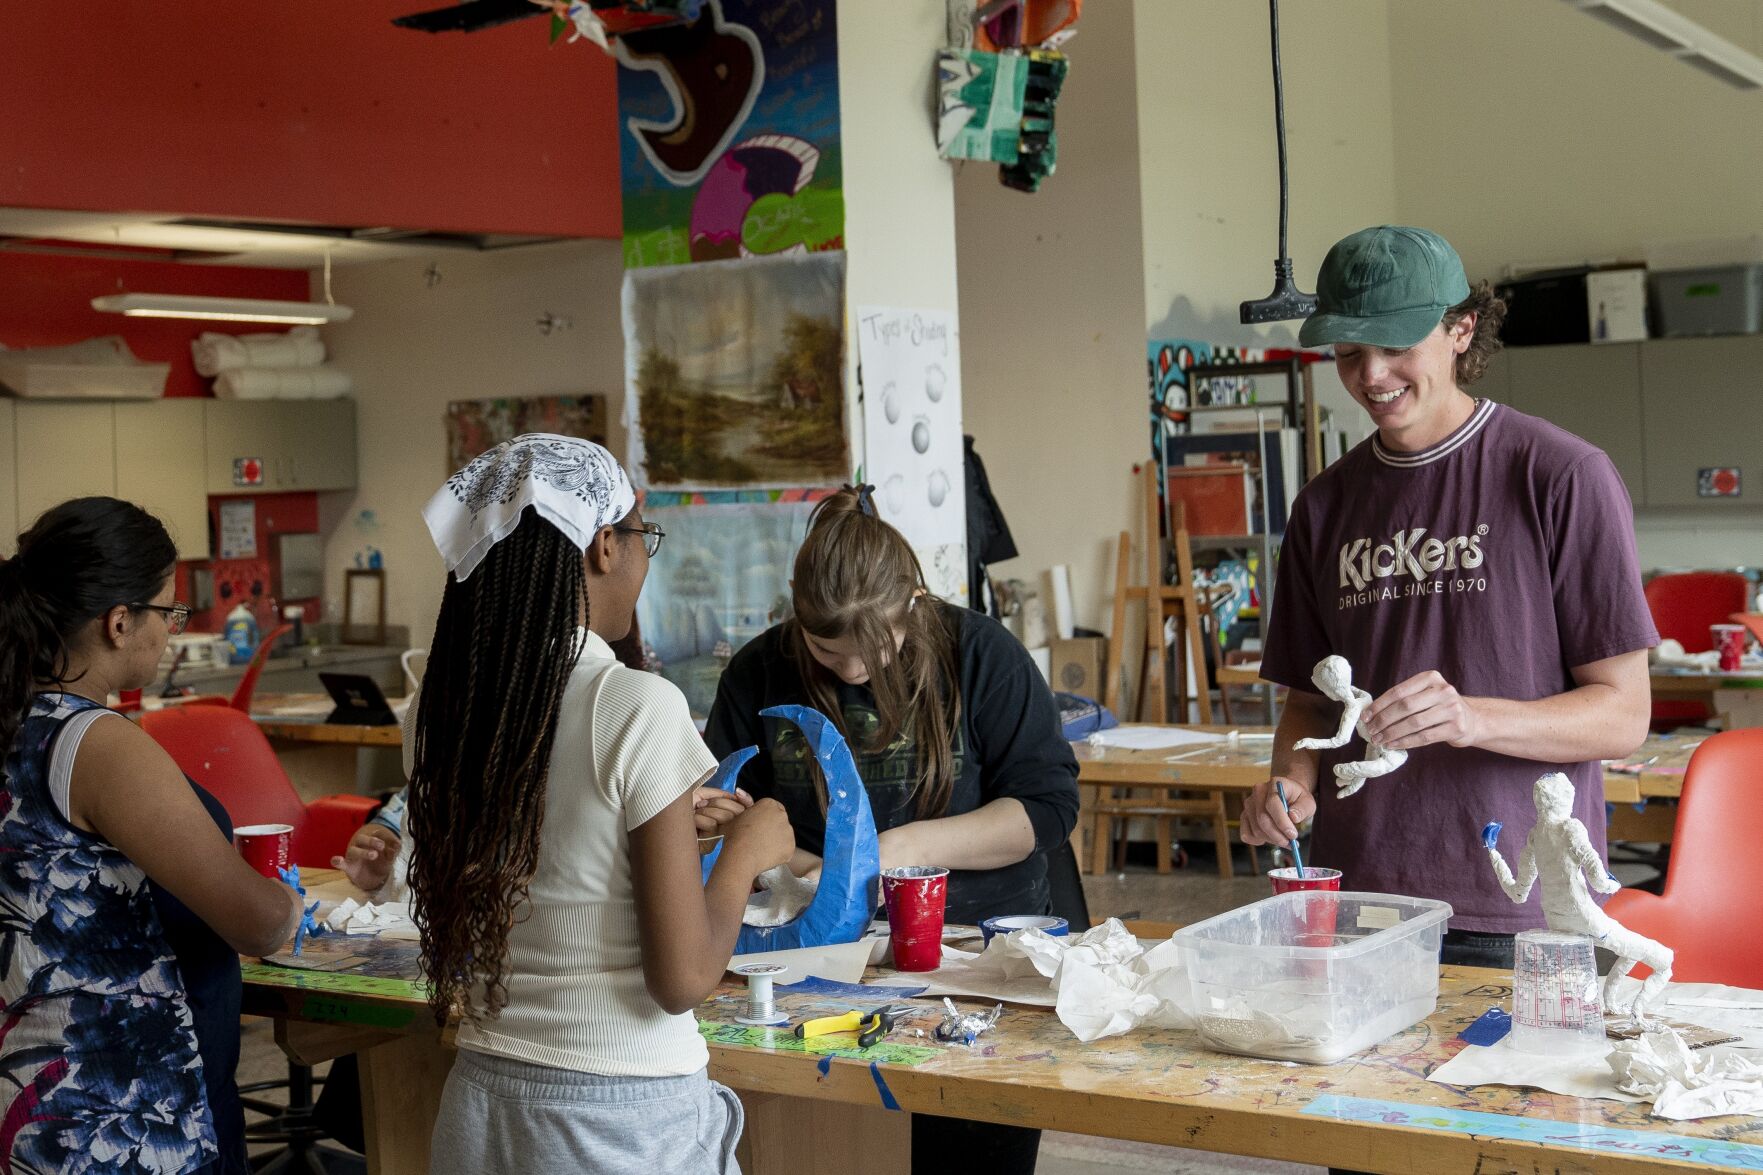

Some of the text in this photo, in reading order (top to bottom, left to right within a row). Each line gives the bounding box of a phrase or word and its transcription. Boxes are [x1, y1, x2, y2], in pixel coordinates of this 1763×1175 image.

[1339, 578, 1487, 610] ORIGINAL SINCE 1970
